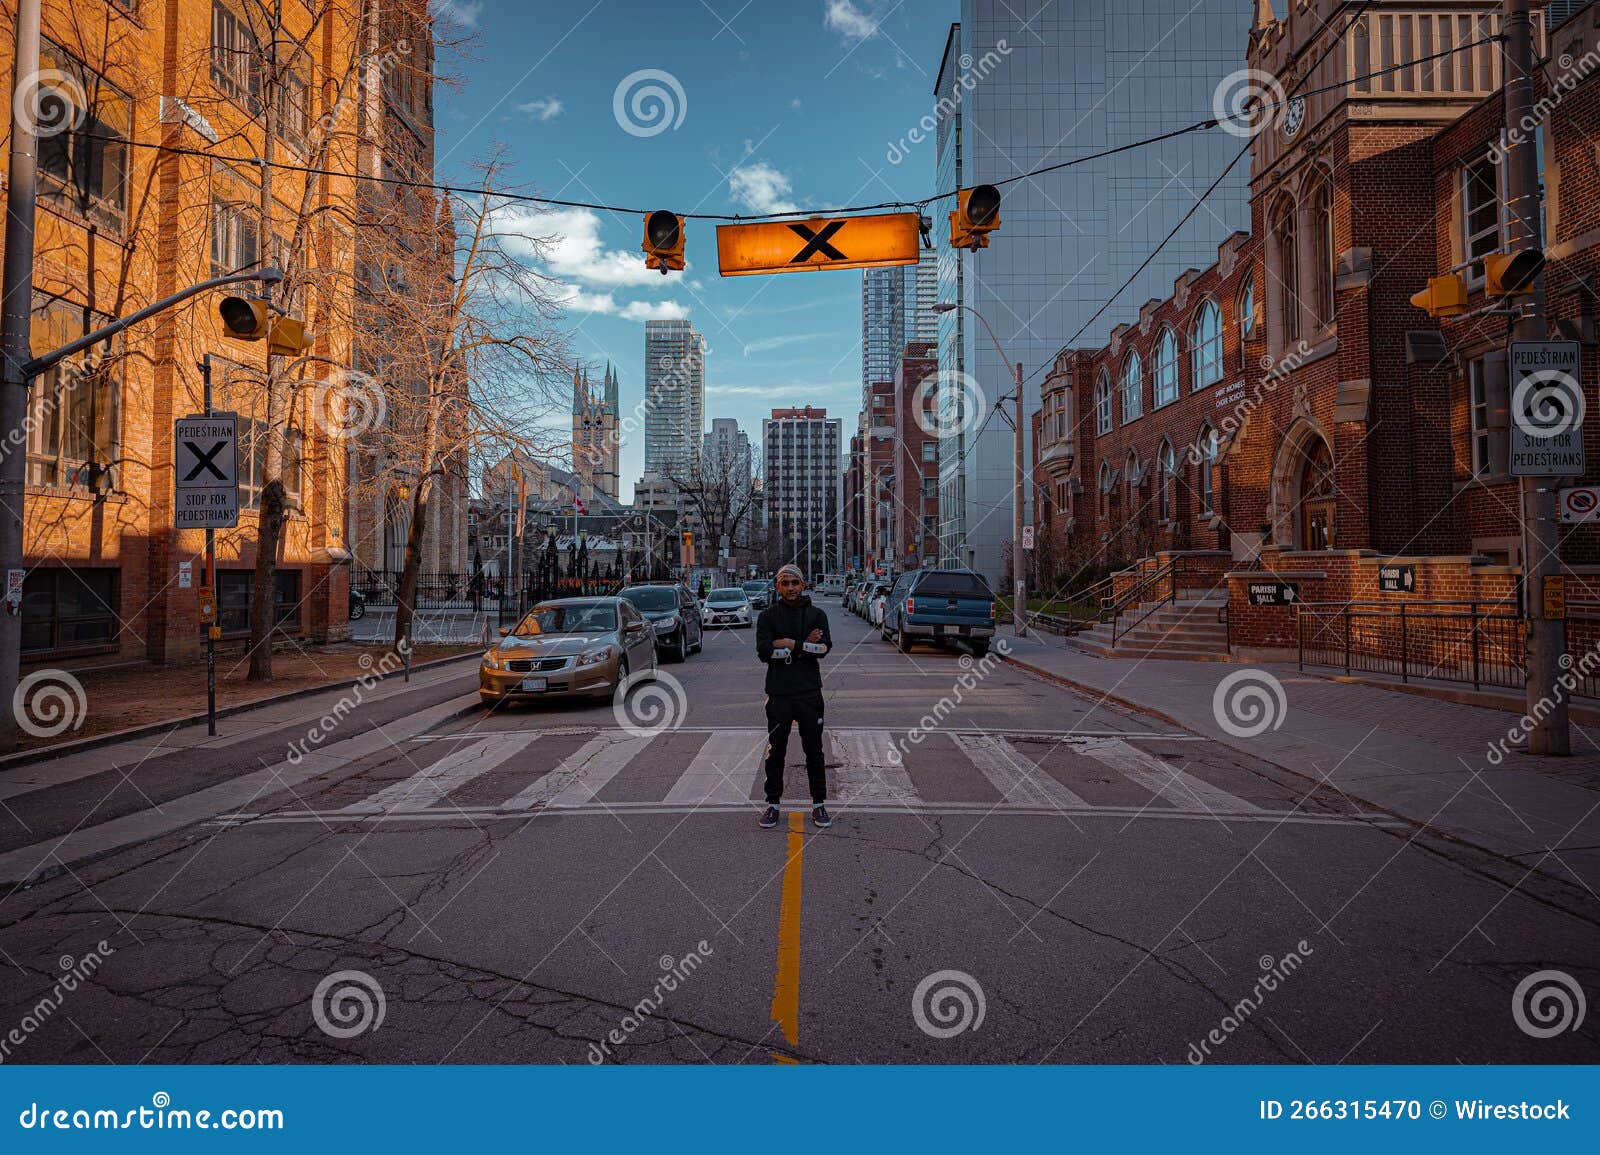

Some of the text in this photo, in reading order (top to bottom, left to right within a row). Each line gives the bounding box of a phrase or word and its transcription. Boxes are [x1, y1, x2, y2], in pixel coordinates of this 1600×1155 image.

[1514, 351, 1576, 365] PEDESTRIAN
[179, 426, 233, 438] PEDESTRIAN
[1523, 433, 1572, 448] STOP FOR
[1513, 452, 1582, 466] PEDESTRIANS
[186, 494, 227, 506] STOP FOR
[177, 509, 236, 521] PEDESTRIANS
[1381, 569, 1400, 579] PARISH
[1251, 585, 1277, 594] PARISH
[1385, 579, 1399, 590] HALL
